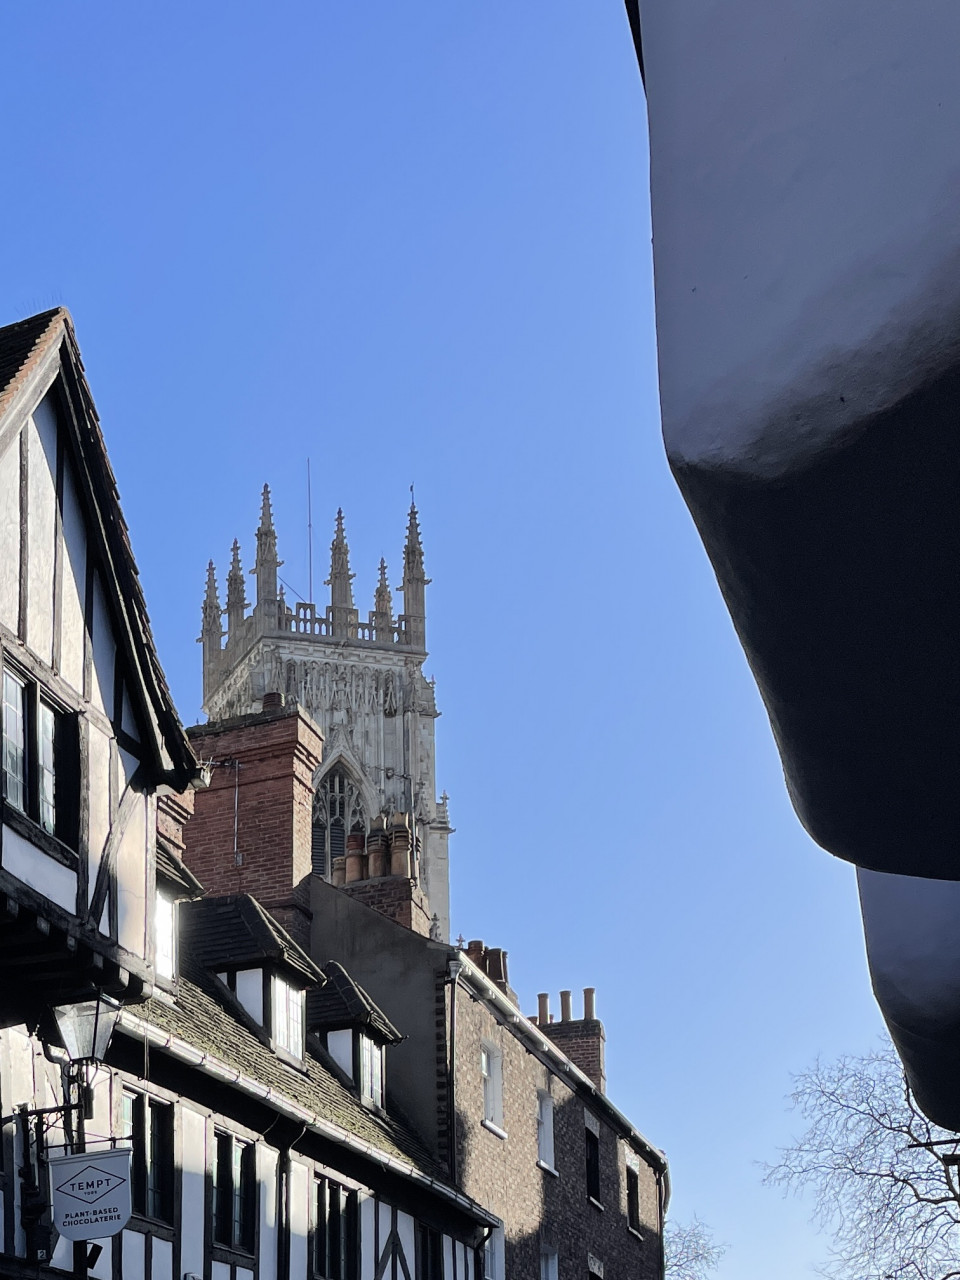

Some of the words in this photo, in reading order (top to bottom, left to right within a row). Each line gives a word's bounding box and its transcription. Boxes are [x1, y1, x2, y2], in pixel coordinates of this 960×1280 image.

[69, 1178, 111, 1191] TEMPT
[65, 1207, 118, 1219] PLANT-BASED
[62, 1214, 121, 1227] CHOCOLATERIE
[39, 1250, 45, 1258] 2
